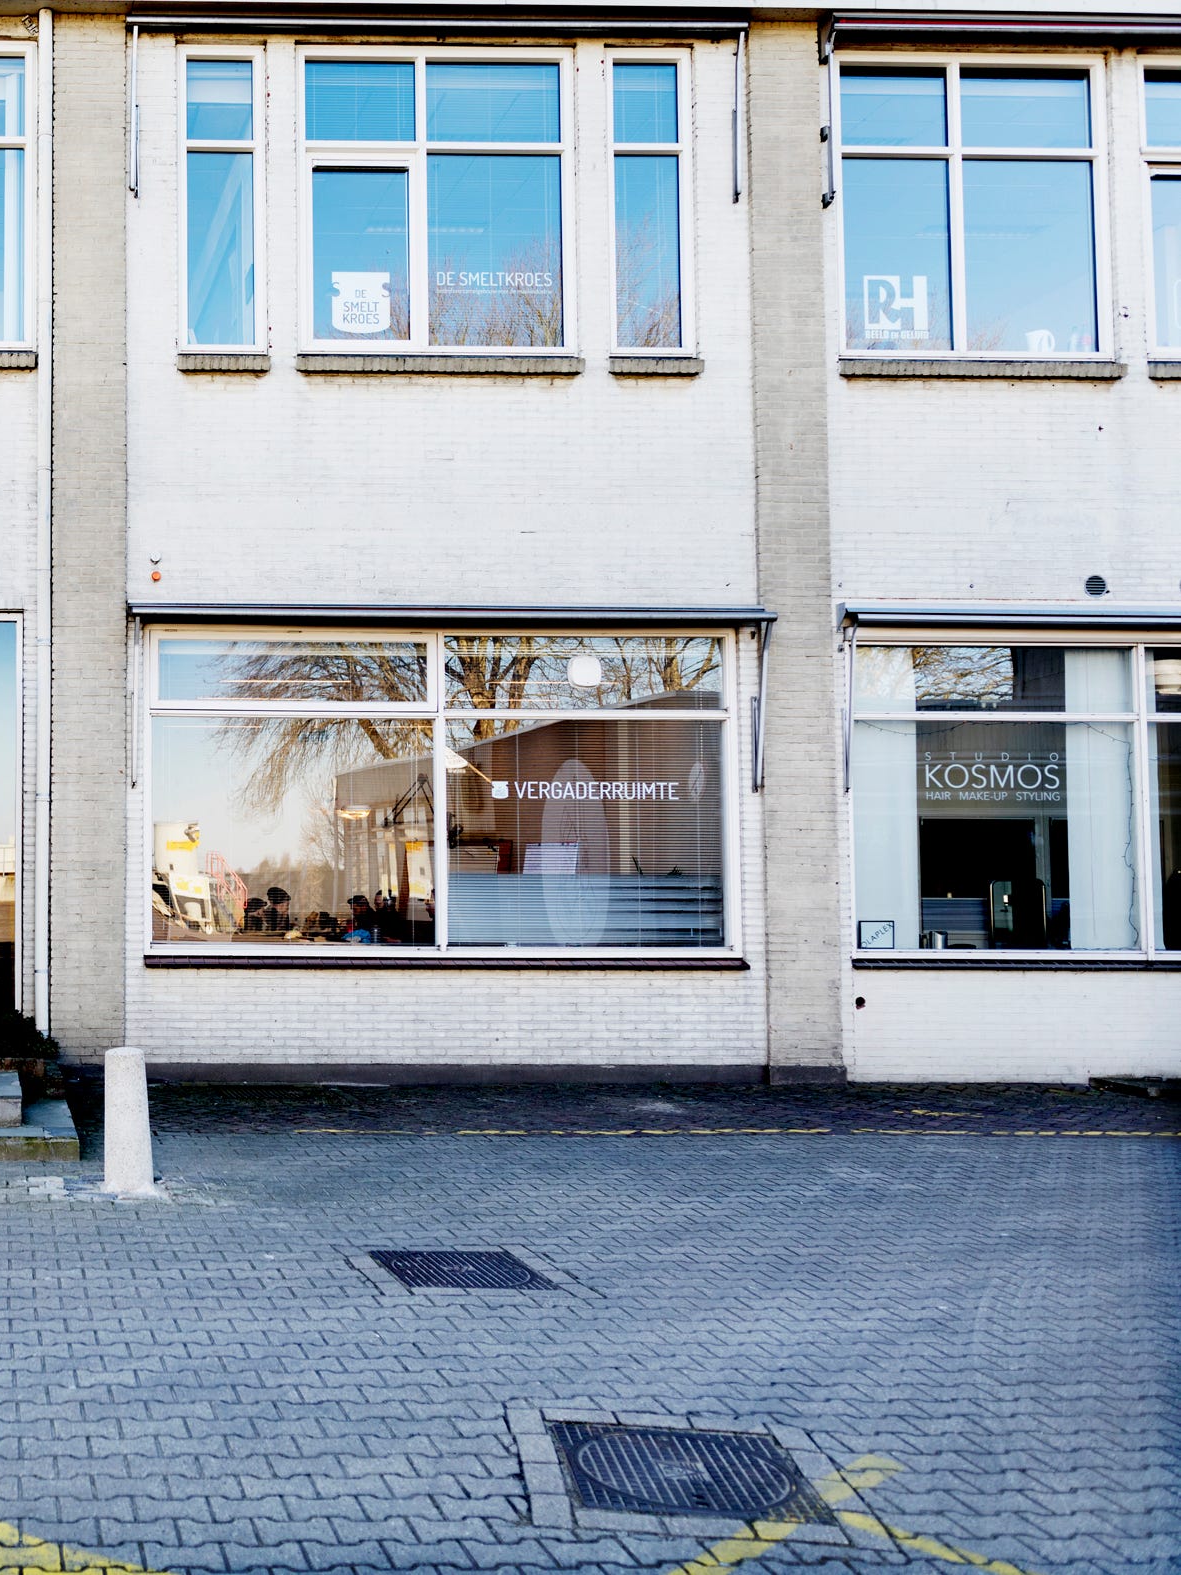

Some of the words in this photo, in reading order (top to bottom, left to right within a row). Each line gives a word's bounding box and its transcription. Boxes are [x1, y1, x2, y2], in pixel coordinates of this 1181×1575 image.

[436, 271, 456, 286] DE
[459, 271, 553, 287] SMELTKROES
[354, 289, 367, 298] DE
[343, 301, 380, 312] SMELT
[342, 313, 380, 324] KROES
[924, 751, 1059, 762] STUDIO
[925, 763, 1060, 789] KOSMOS
[514, 781, 680, 800] VERGADERRUIMTE
[925, 791, 952, 801] HAIR
[959, 791, 1008, 801] MAKE-UP
[1016, 791, 1061, 801] STYLING
